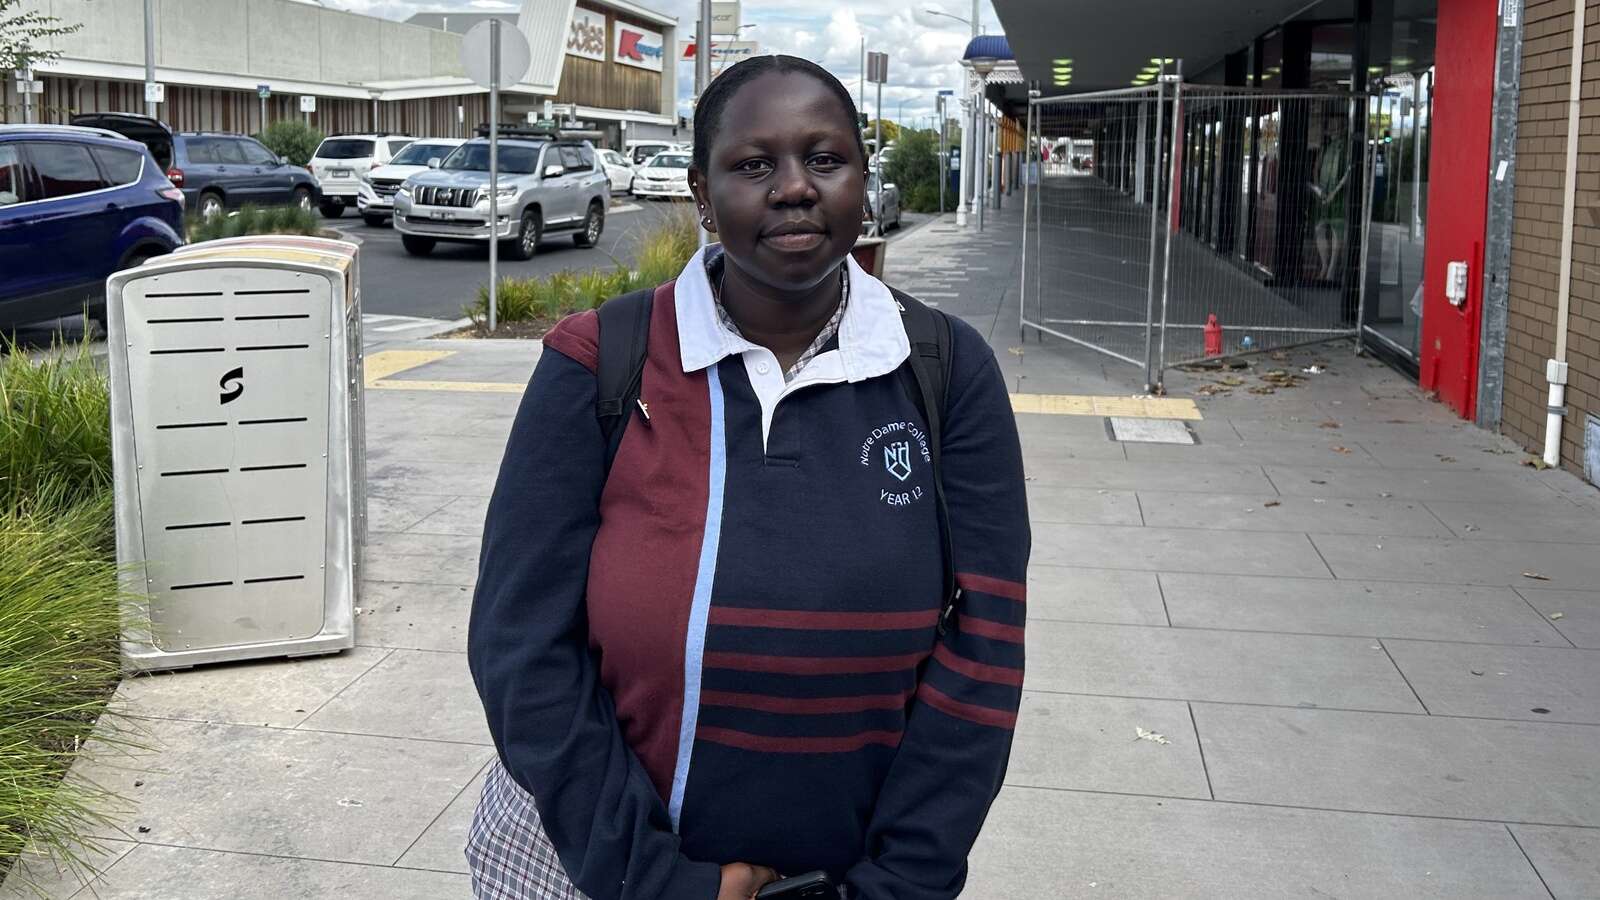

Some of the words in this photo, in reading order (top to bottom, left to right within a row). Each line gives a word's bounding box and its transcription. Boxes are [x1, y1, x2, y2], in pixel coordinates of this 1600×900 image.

[860, 437, 875, 466] Notre
[872, 421, 906, 439] Dame
[907, 422, 931, 462] College
[880, 488, 911, 506] YEAR
[912, 485, 923, 500] 12
